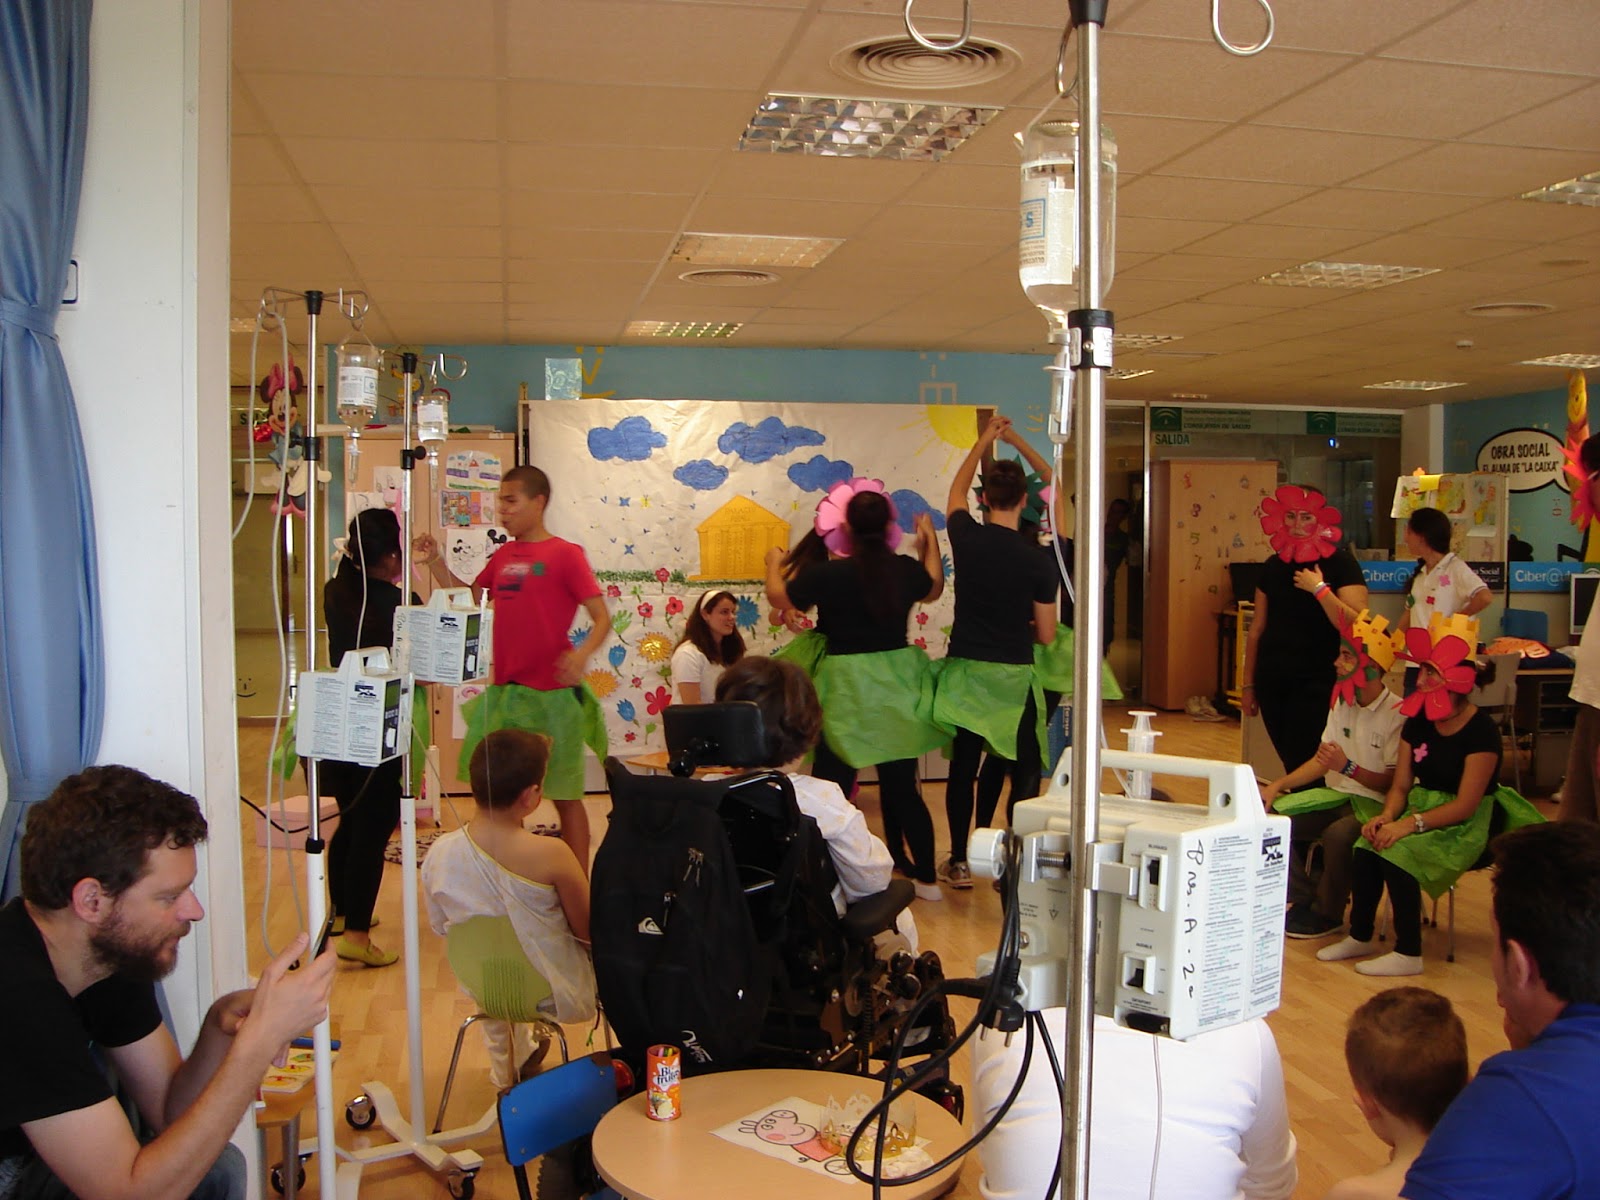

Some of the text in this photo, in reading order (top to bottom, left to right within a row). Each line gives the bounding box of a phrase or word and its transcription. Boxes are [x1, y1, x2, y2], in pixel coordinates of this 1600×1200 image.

[1155, 433, 1190, 445] SALIDA
[1491, 442, 1550, 460] OBRA SOCIAL
[1491, 462, 1511, 473] ALMA
[1512, 461, 1520, 473] DE
